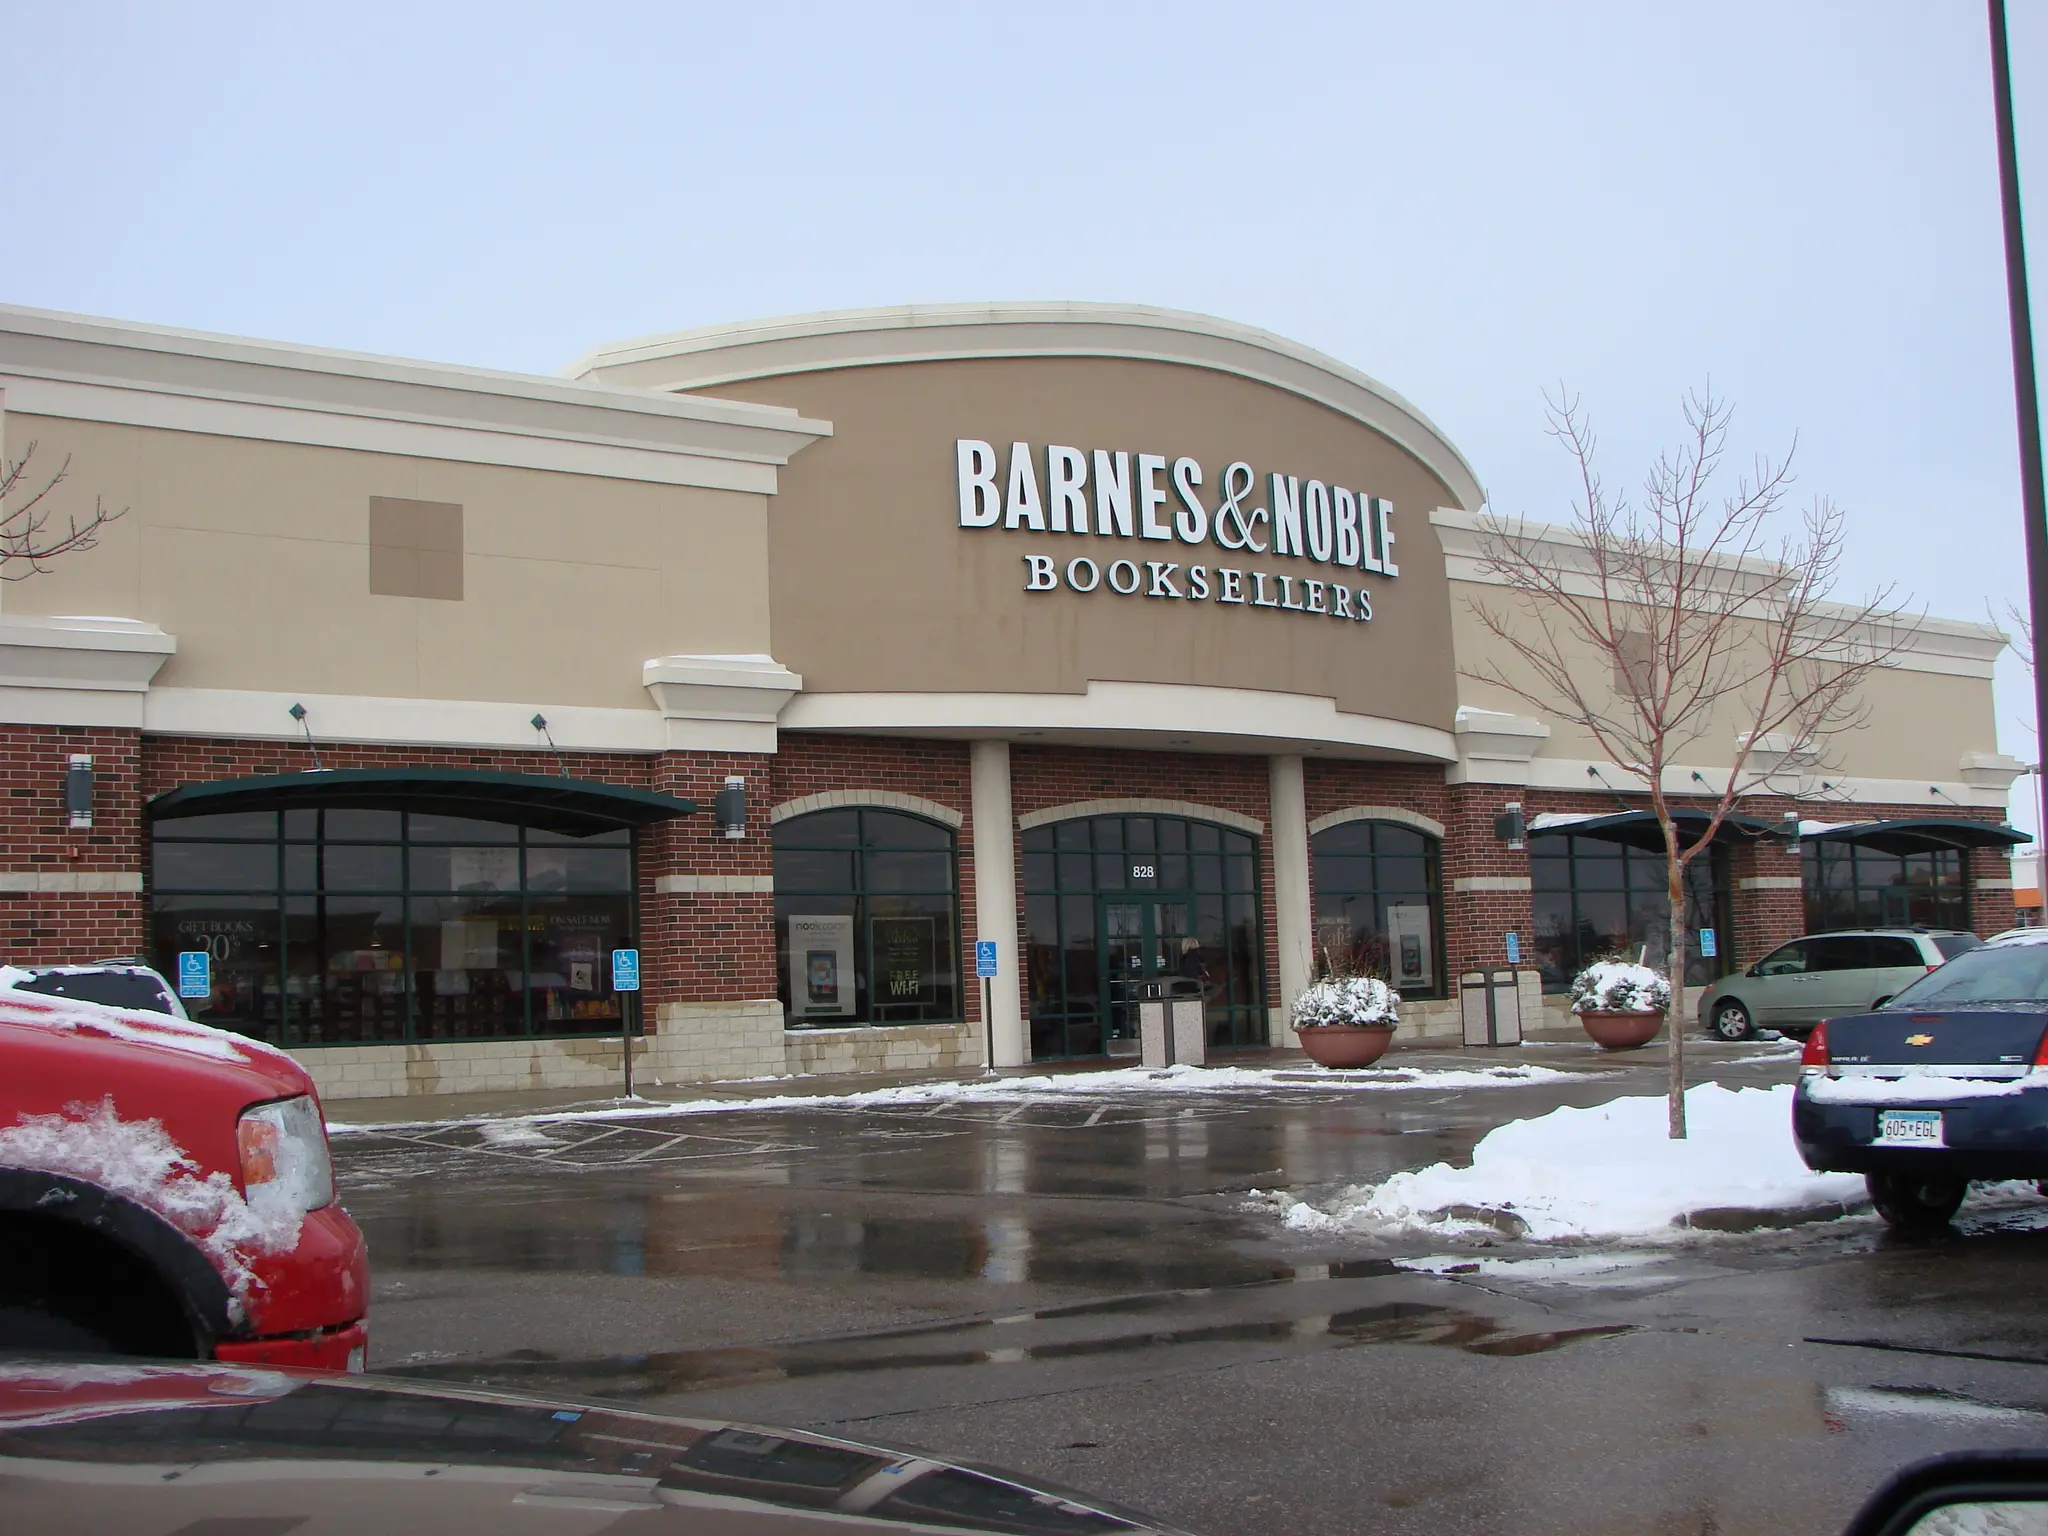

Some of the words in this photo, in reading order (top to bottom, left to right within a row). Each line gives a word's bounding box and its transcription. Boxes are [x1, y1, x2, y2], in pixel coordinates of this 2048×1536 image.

[956, 438, 1208, 544] BARNES
[1212, 461, 1269, 554] &
[1270, 472, 1399, 578] NOBLE
[1023, 554, 1373, 622] BOOKSELLERS
[1133, 866, 1154, 878] 828
[178, 920, 209, 933] GIFT
[210, 920, 253, 933] BOOKS
[890, 970, 919, 980] FREE
[890, 980, 919, 996] Wi-Fi
[1886, 1120, 1907, 1136] 605
[1915, 1120, 1937, 1137] EGL
